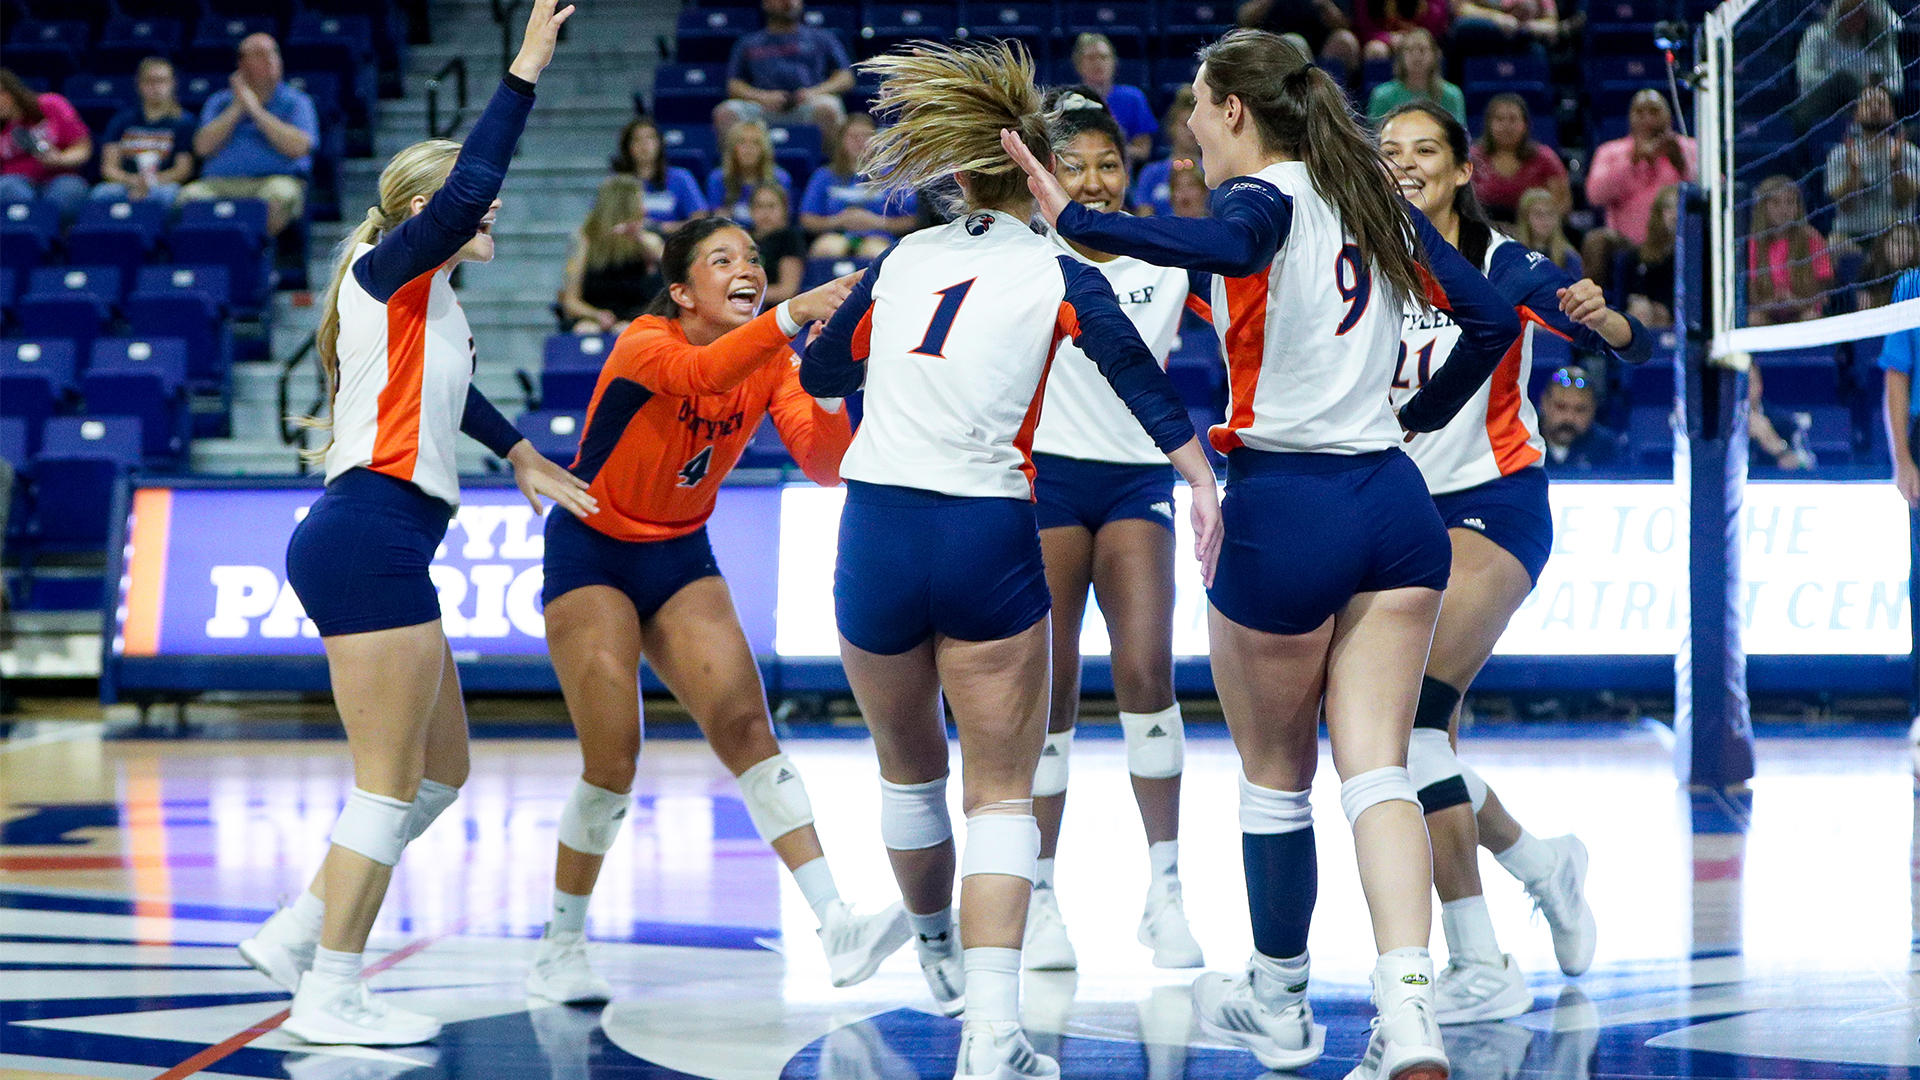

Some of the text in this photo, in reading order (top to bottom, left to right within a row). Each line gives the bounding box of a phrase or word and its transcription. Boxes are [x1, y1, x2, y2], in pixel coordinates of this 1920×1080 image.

[1116, 285, 1154, 305] LER
[1334, 243, 1373, 336] 9
[906, 275, 979, 360] 1
[1391, 335, 1437, 389] 21
[676, 444, 714, 488] 4
[1611, 505, 1677, 555] TO
[1746, 505, 1818, 555] HE
